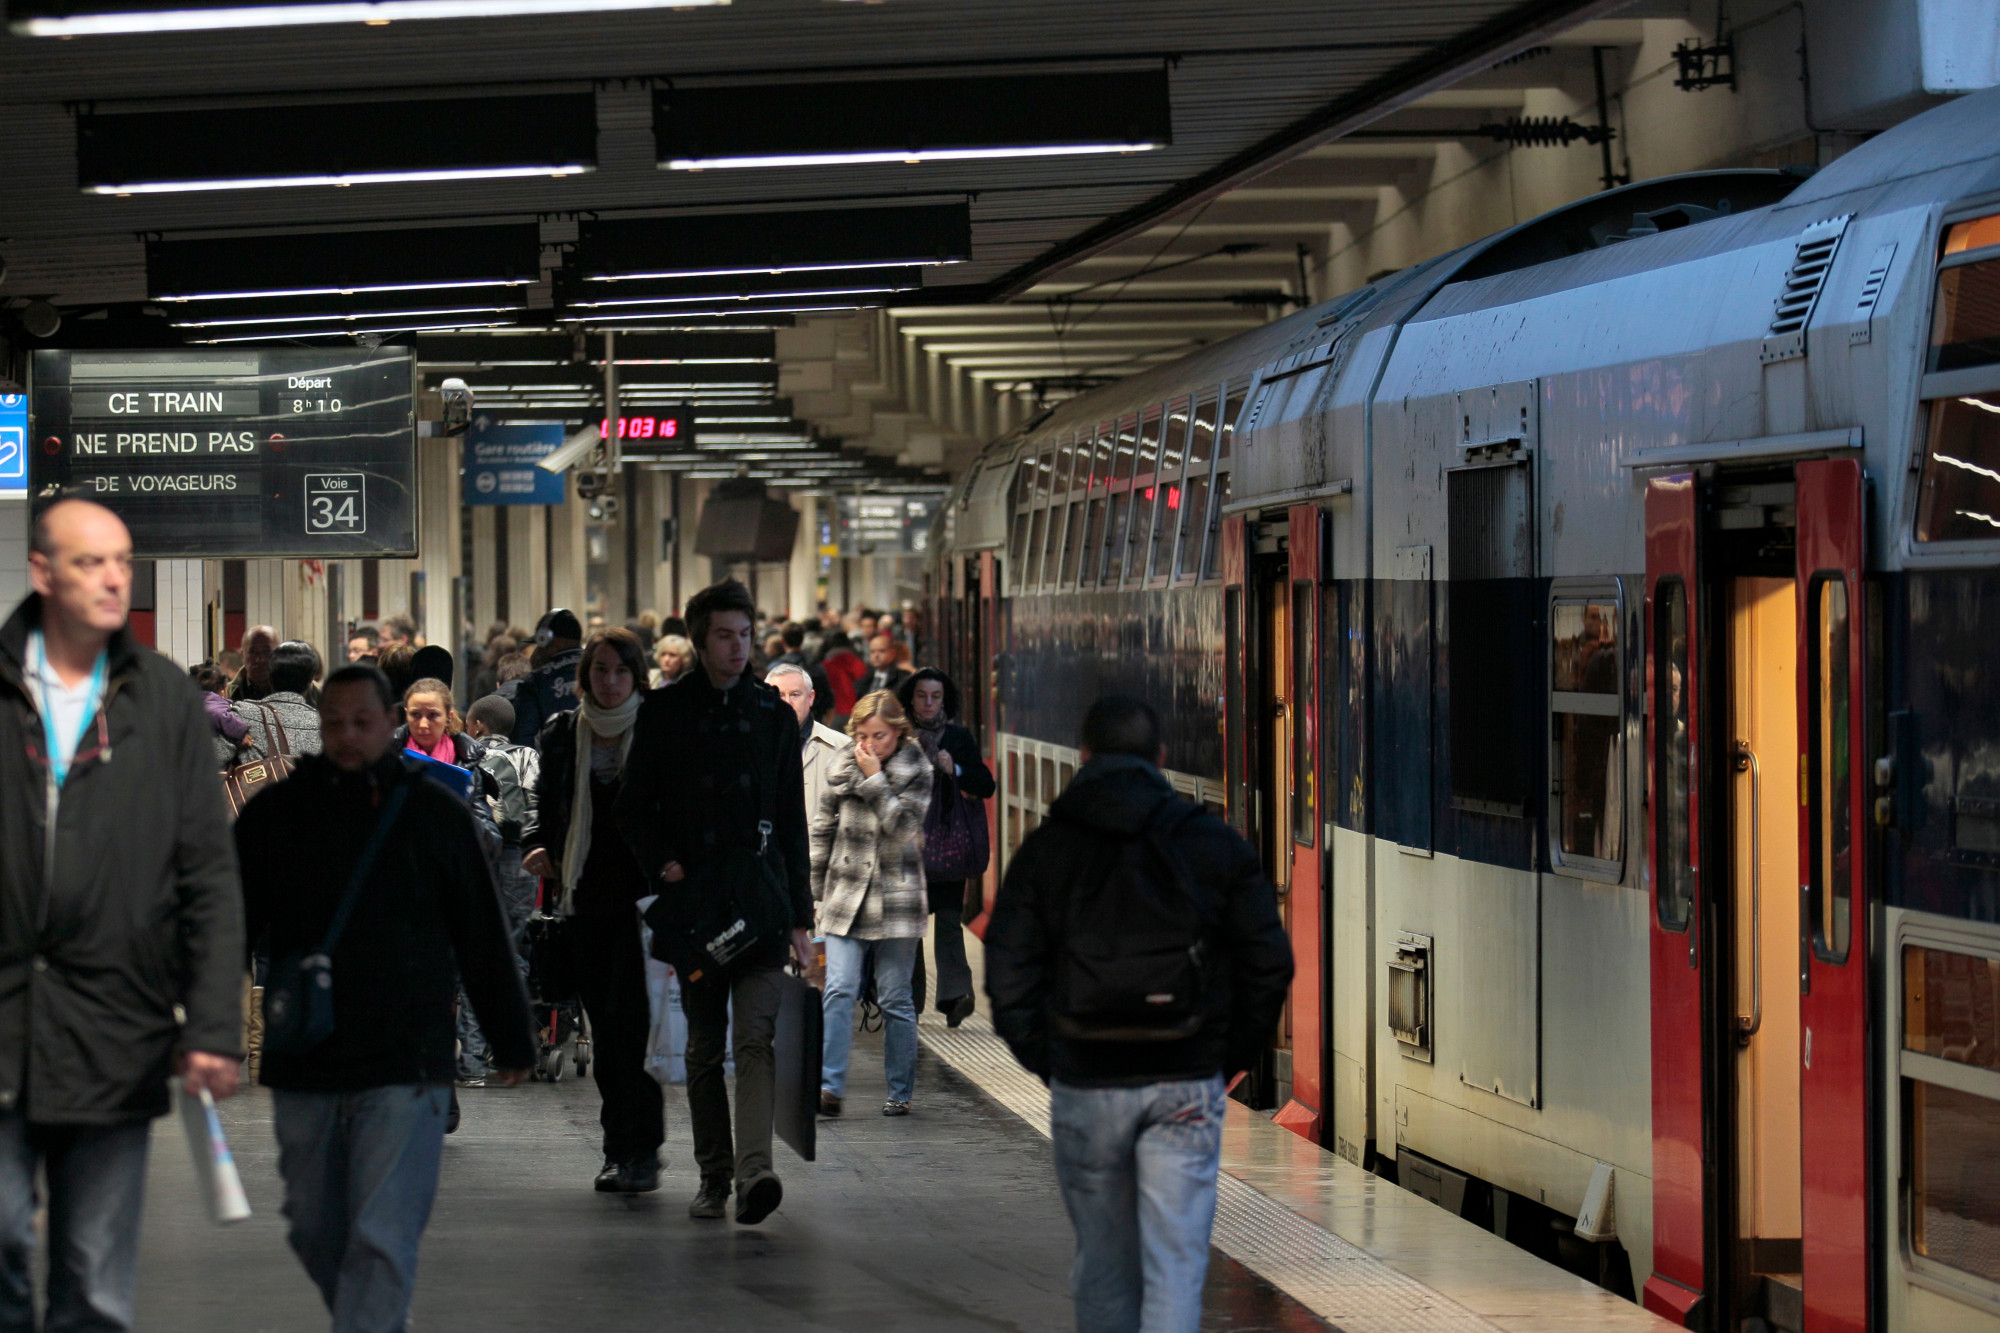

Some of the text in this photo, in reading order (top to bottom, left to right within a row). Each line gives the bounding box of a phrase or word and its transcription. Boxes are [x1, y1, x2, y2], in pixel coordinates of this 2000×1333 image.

[288, 376, 332, 390] Départ
[108, 391, 224, 414] CE TRAIN
[75, 431, 255, 455] NE PREND PAS
[95, 474, 237, 492] DE VOYAGEURS
[320, 477, 349, 490] Voie
[311, 496, 360, 529] 34
